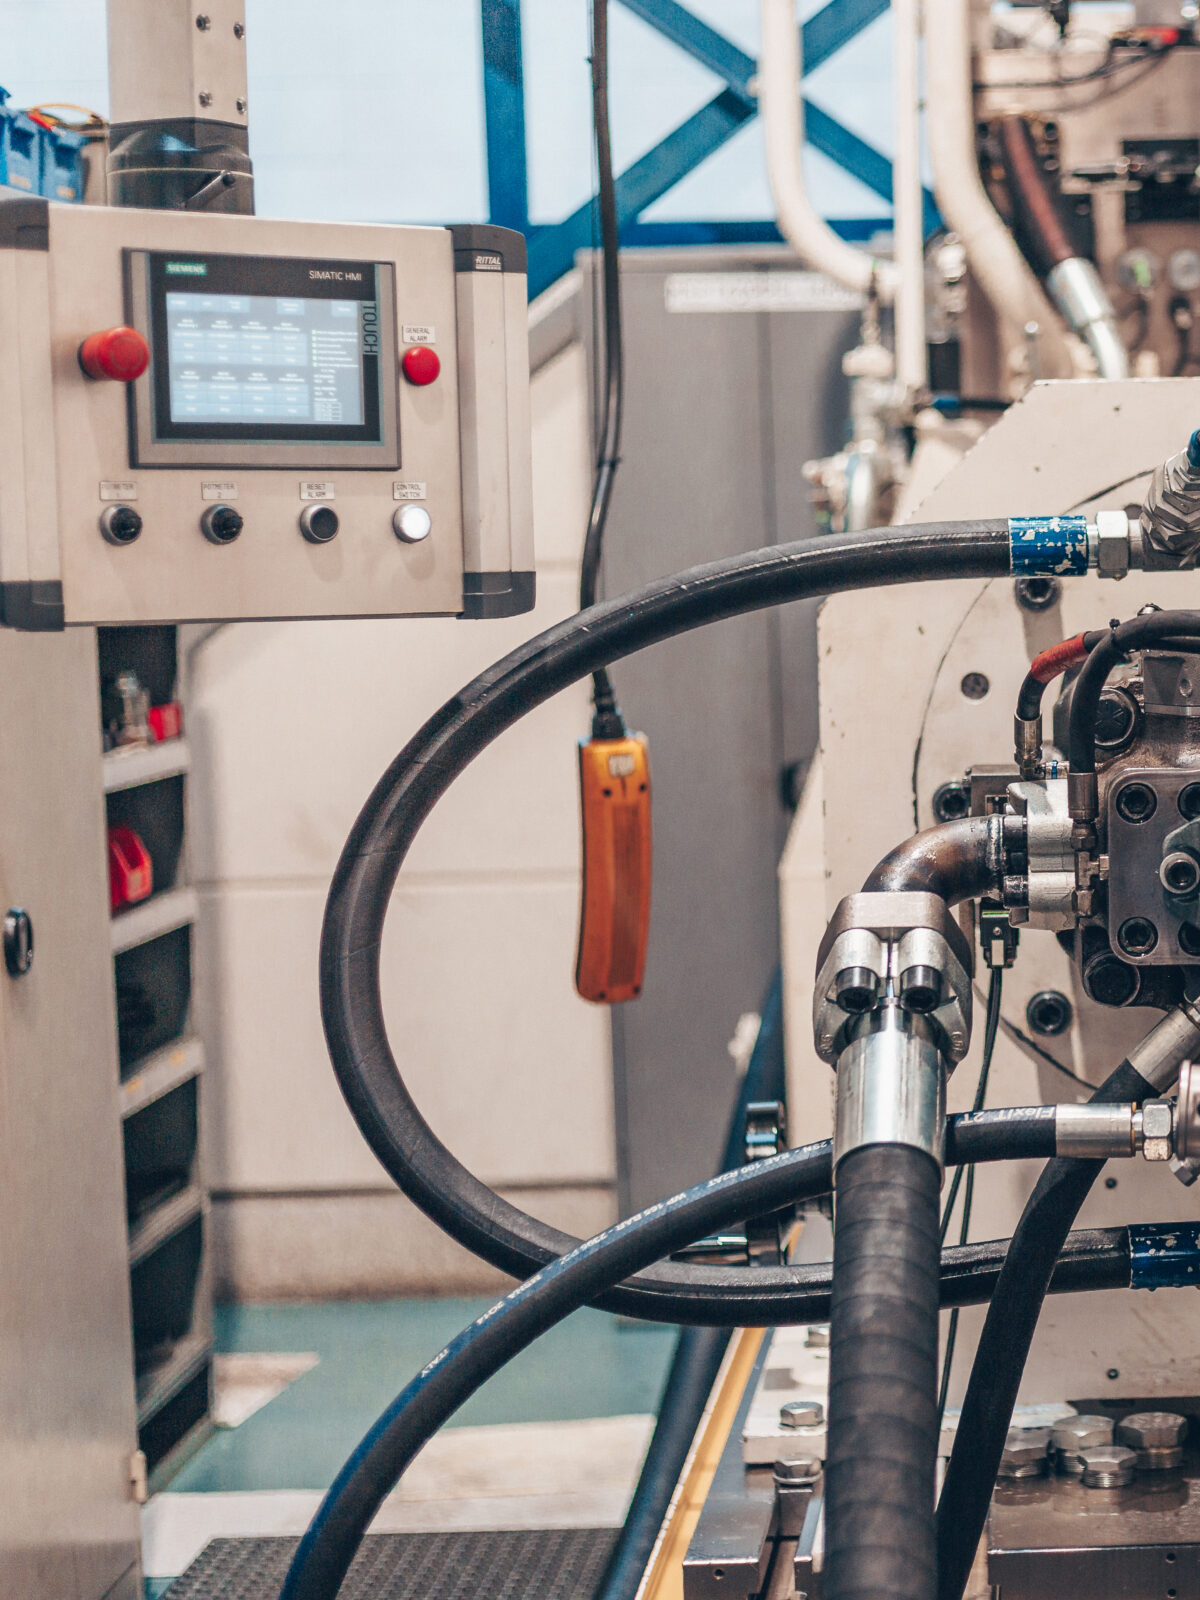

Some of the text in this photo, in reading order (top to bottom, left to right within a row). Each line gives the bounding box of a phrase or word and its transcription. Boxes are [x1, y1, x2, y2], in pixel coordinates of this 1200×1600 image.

[475, 255, 501, 265] RITTAL
[167, 264, 205, 274] SIEMENS
[309, 270, 362, 281] SIMATIC HMI
[362, 303, 378, 354] TOUCH
[405, 327, 430, 335] GENERAL
[396, 483, 421, 491] CONTROL
[960, 1106, 1055, 1125] FlexIT 2T
[766, 1152, 790, 1164] SAE
[740, 1163, 761, 1175] 100
[707, 1171, 739, 1188] R2AT
[664, 1192, 687, 1206] WP
[615, 1212, 643, 1231] BAR
[420, 1348, 449, 1378] ITALY
